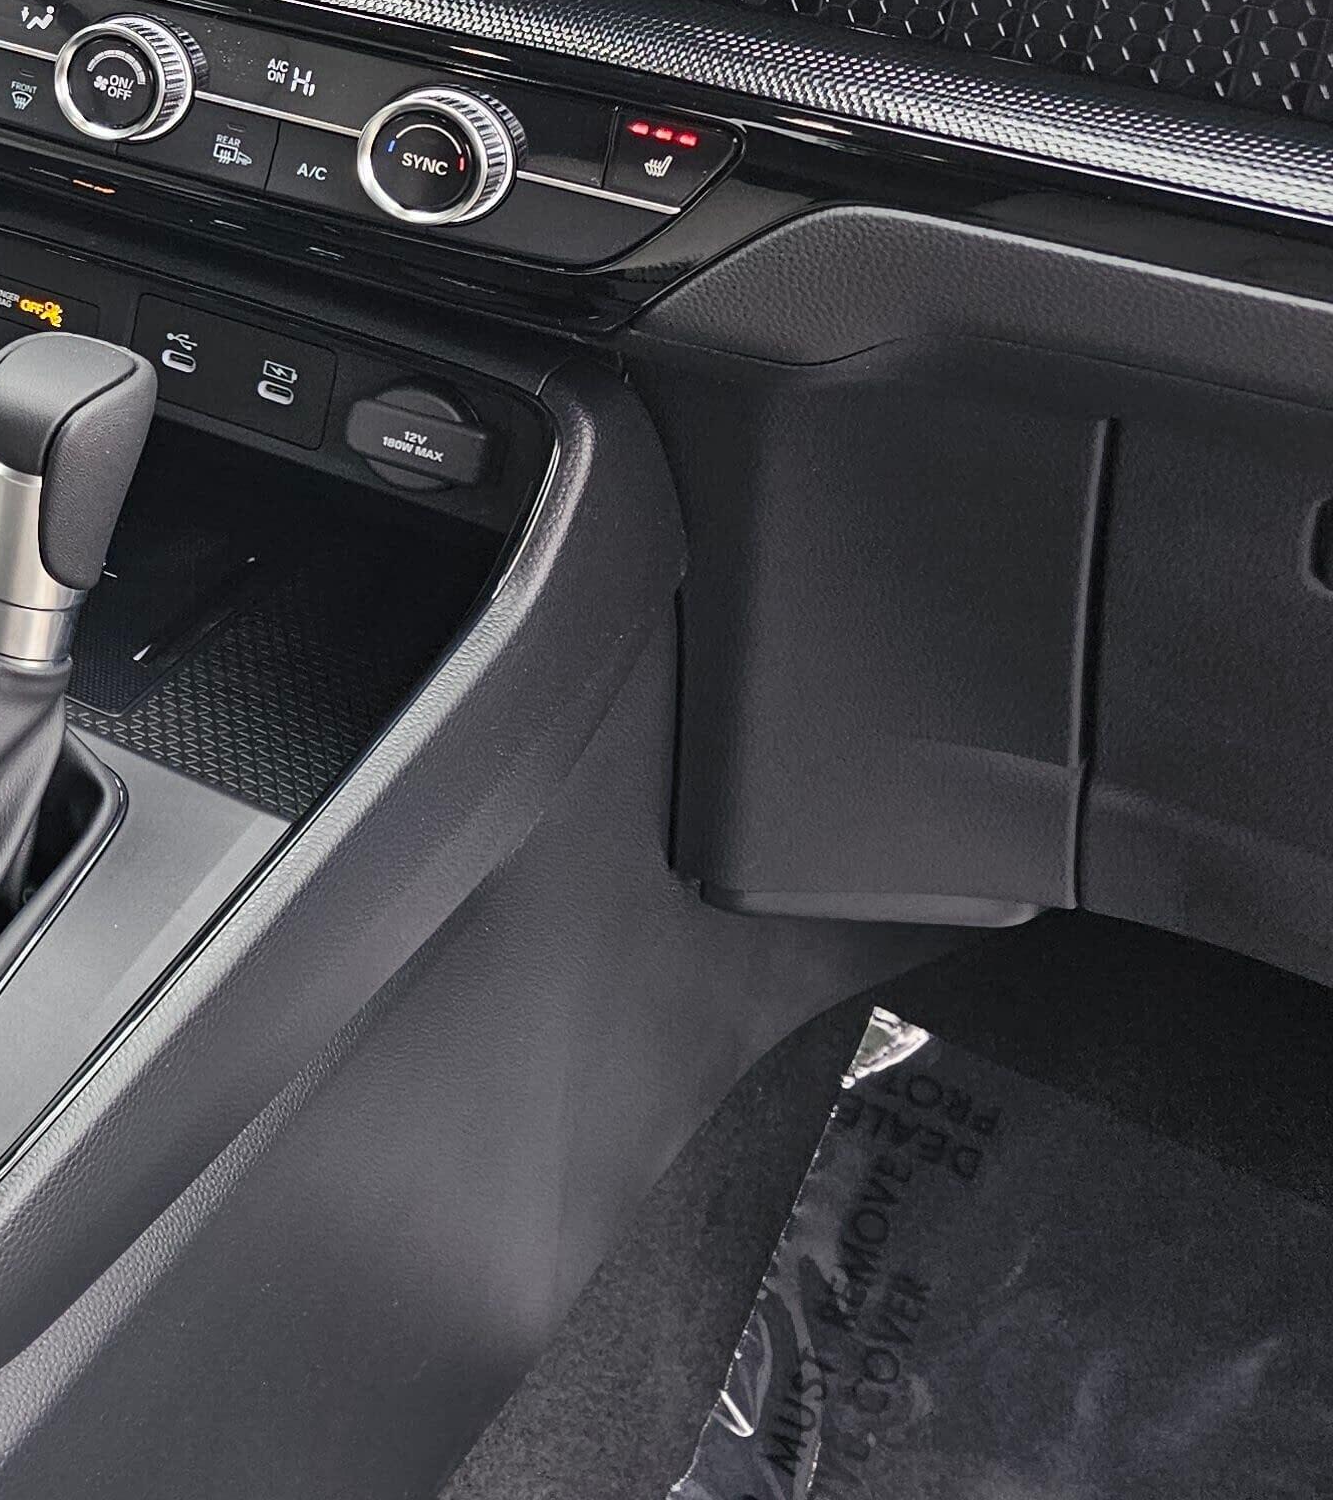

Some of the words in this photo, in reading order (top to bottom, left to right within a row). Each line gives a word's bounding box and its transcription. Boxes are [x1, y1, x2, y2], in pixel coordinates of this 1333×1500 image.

[267, 57, 289, 74] A/C
[109, 74, 134, 90] ON/
[267, 70, 285, 84] ON
[11, 80, 37, 93] FRONT
[107, 84, 132, 101] OFF
[216, 133, 242, 148] REAR
[297, 162, 327, 181] A/C
[401, 151, 449, 176] SYNC
[19, 299, 44, 314] OFF
[404, 430, 428, 445] 12V
[382, 436, 413, 453] 180W
[414, 445, 444, 462] MAX
